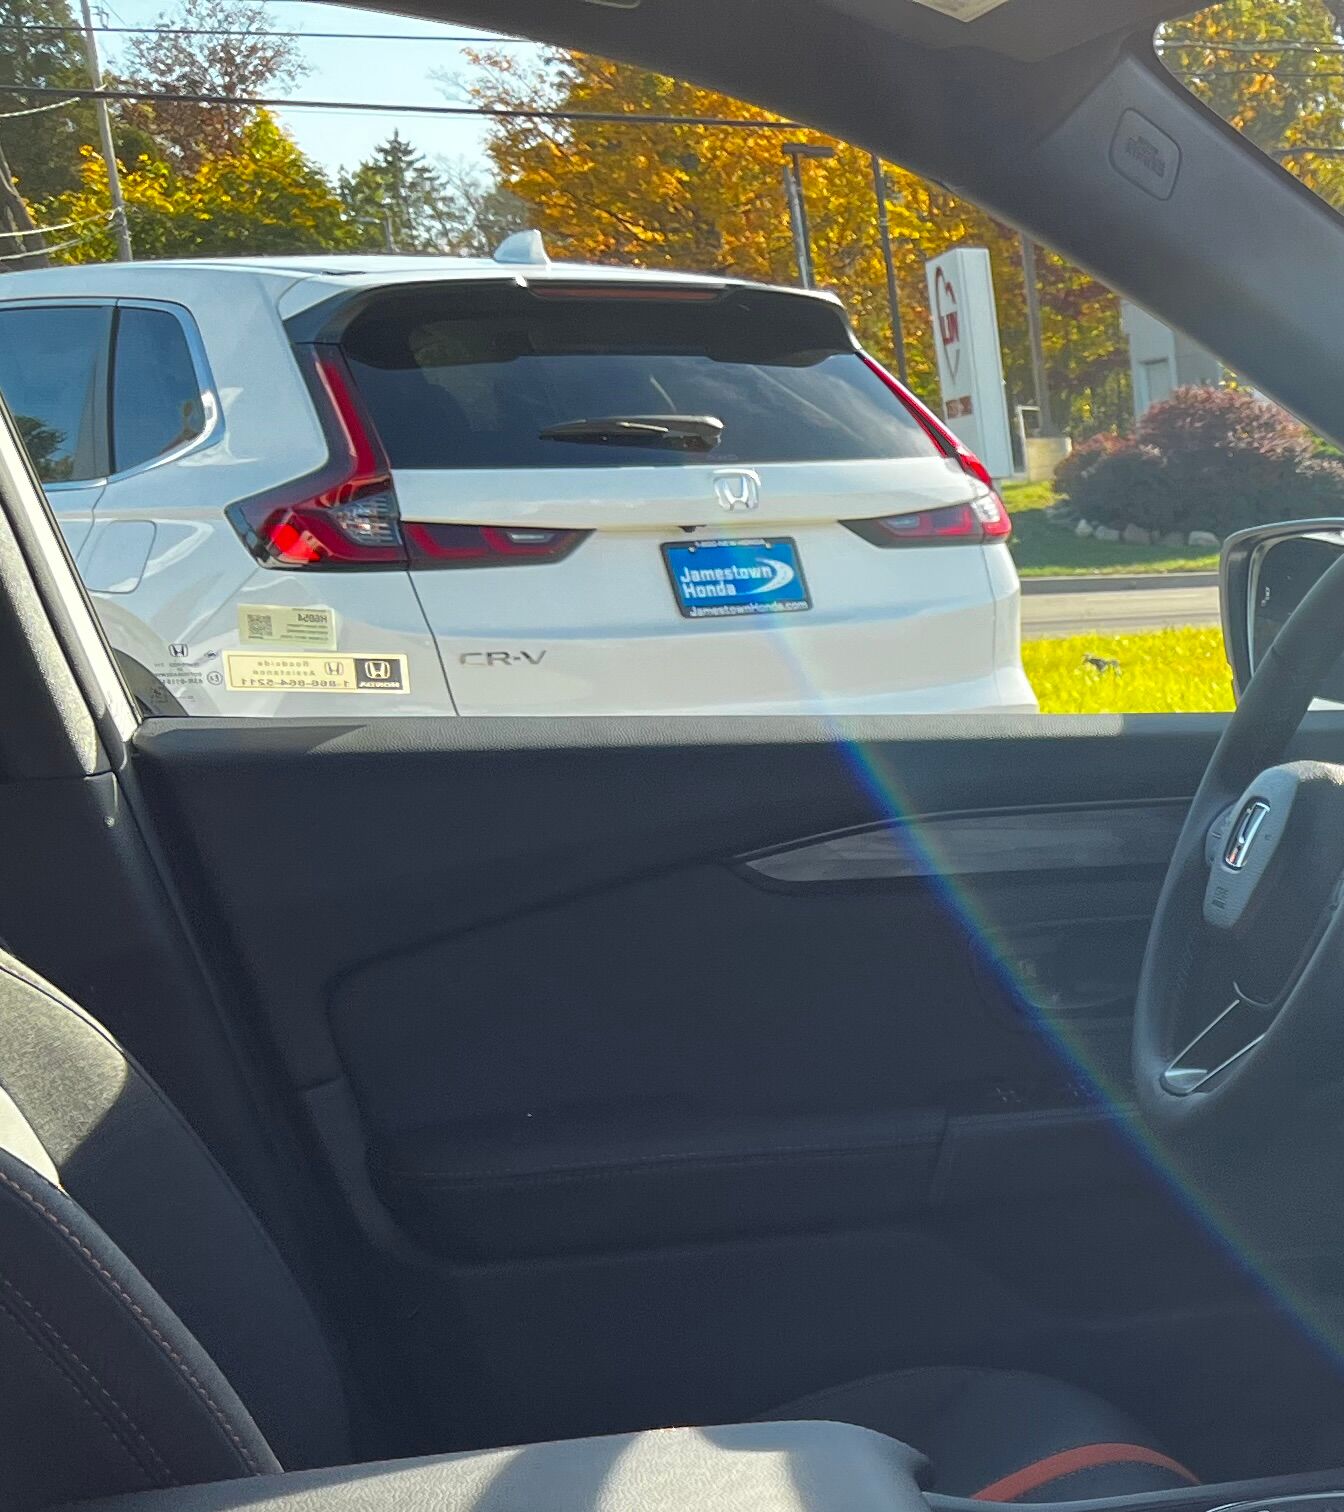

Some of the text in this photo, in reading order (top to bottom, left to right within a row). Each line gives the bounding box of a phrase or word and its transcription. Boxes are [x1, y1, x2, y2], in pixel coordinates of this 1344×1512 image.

[680, 565, 773, 583] Jamestown
[682, 580, 737, 599] Honda
[689, 601, 809, 617] JamestownHonda.com
[459, 650, 547, 666] CR-V
